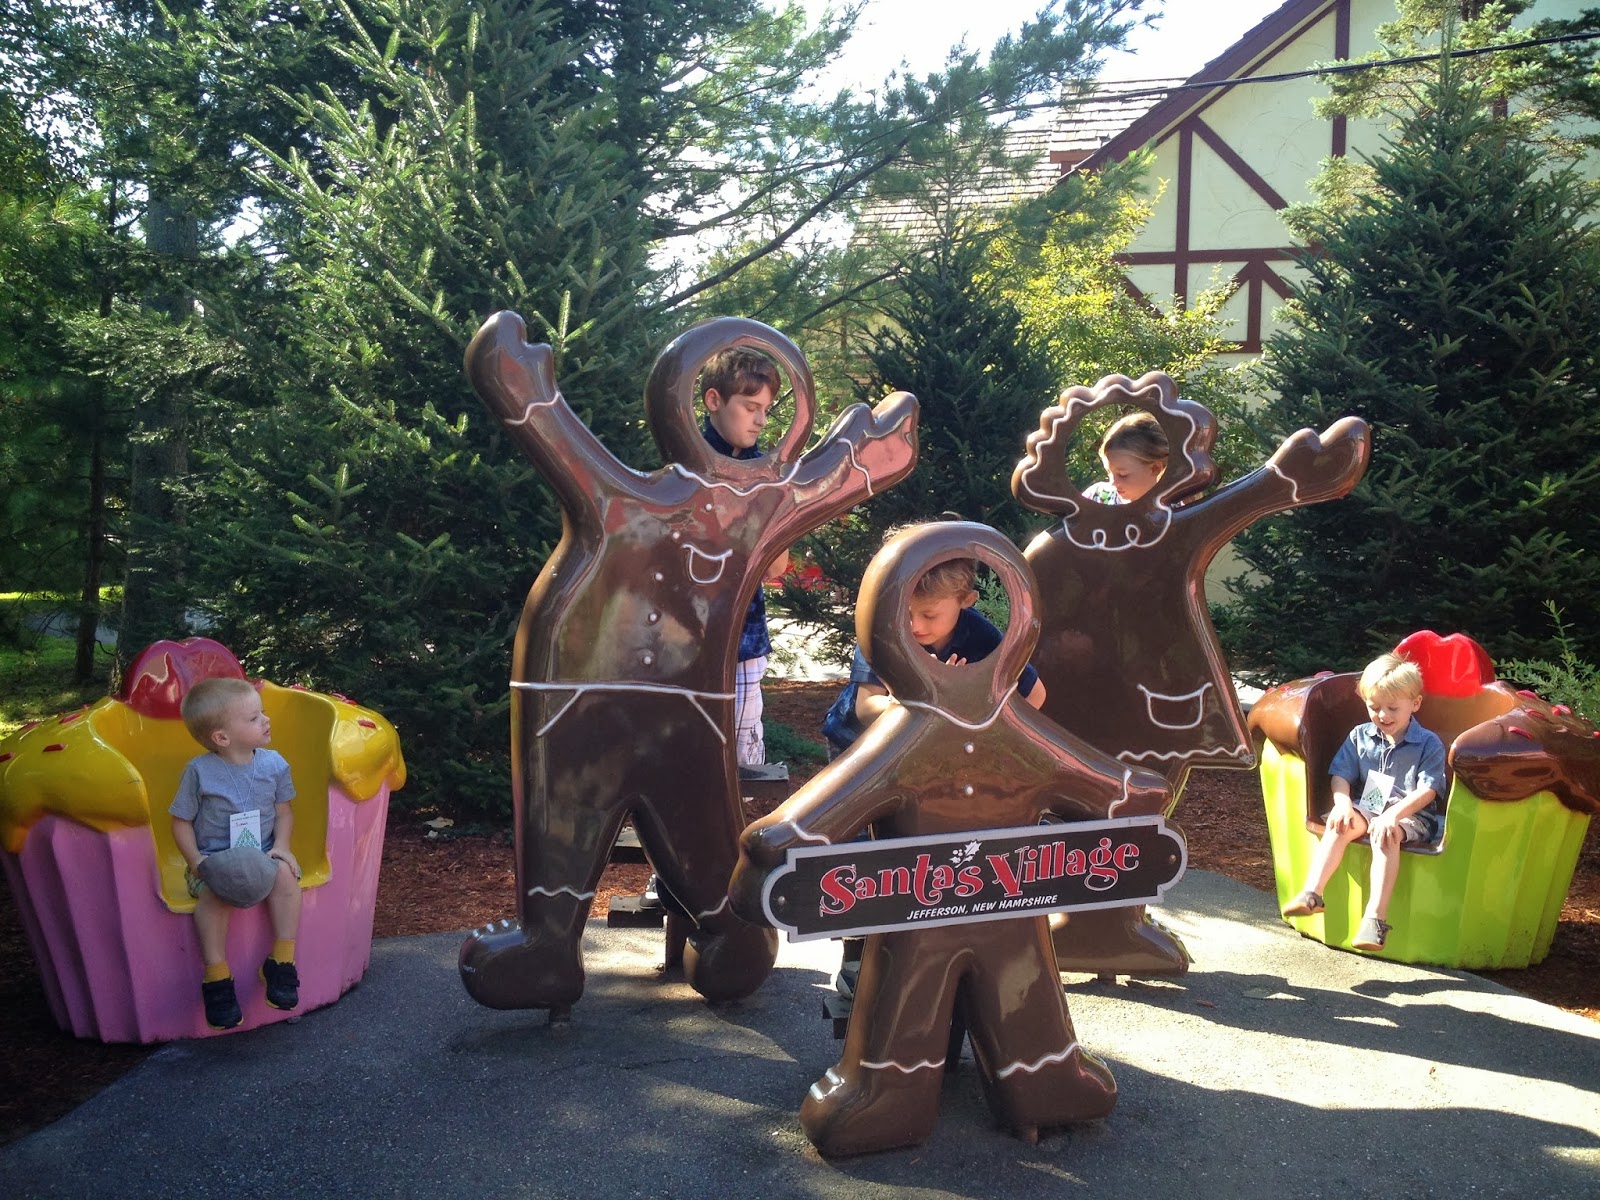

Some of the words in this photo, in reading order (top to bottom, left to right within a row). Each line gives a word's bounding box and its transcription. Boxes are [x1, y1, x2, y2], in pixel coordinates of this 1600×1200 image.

[985, 836, 1140, 898] Village
[906, 903, 969, 921] JEFFERSON,
[971, 900, 997, 913] NEW
[998, 894, 1059, 911] HAMPSHIRE
